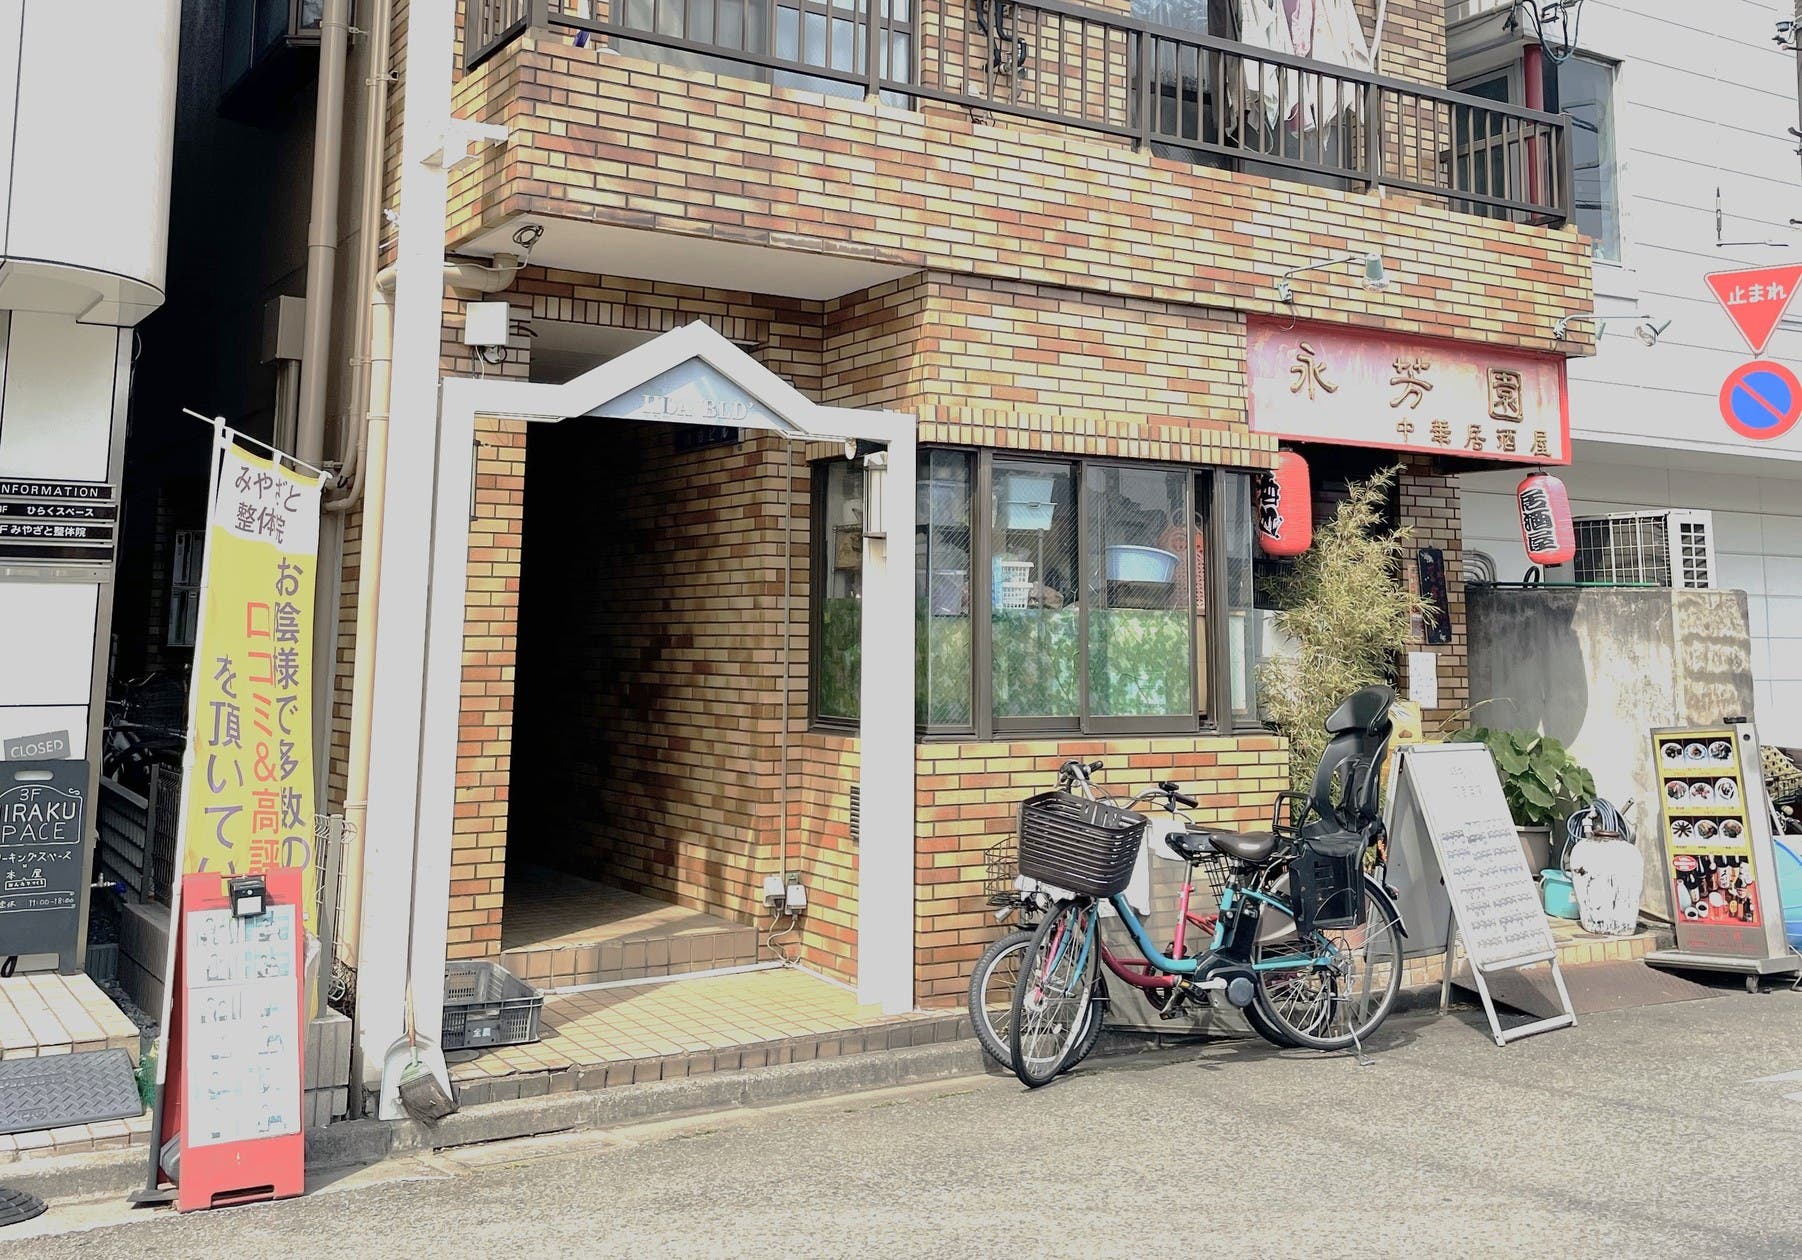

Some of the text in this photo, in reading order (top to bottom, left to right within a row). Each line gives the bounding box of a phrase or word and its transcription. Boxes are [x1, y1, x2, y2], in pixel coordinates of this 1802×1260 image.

[1727, 282, 1787, 305] 止まれ
[1289, 341, 1524, 423] 永芳園
[1396, 417, 1552, 457] 中華居酒屋
[0, 484, 98, 497] NFORMATION
[234, 466, 301, 512] みやざと
[26, 506, 94, 517] ひらくスペース
[234, 501, 286, 544] 整体院
[1519, 487, 1558, 553] 居酒屋
[0, 525, 87, 537] F みやざと整体院
[10, 739, 64, 759] CLOSED
[19, 788, 42, 801] 3F
[0, 801, 76, 823] IRAKU
[0, 821, 67, 844] PACE
[0, 850, 72, 864] ーキングスペース
